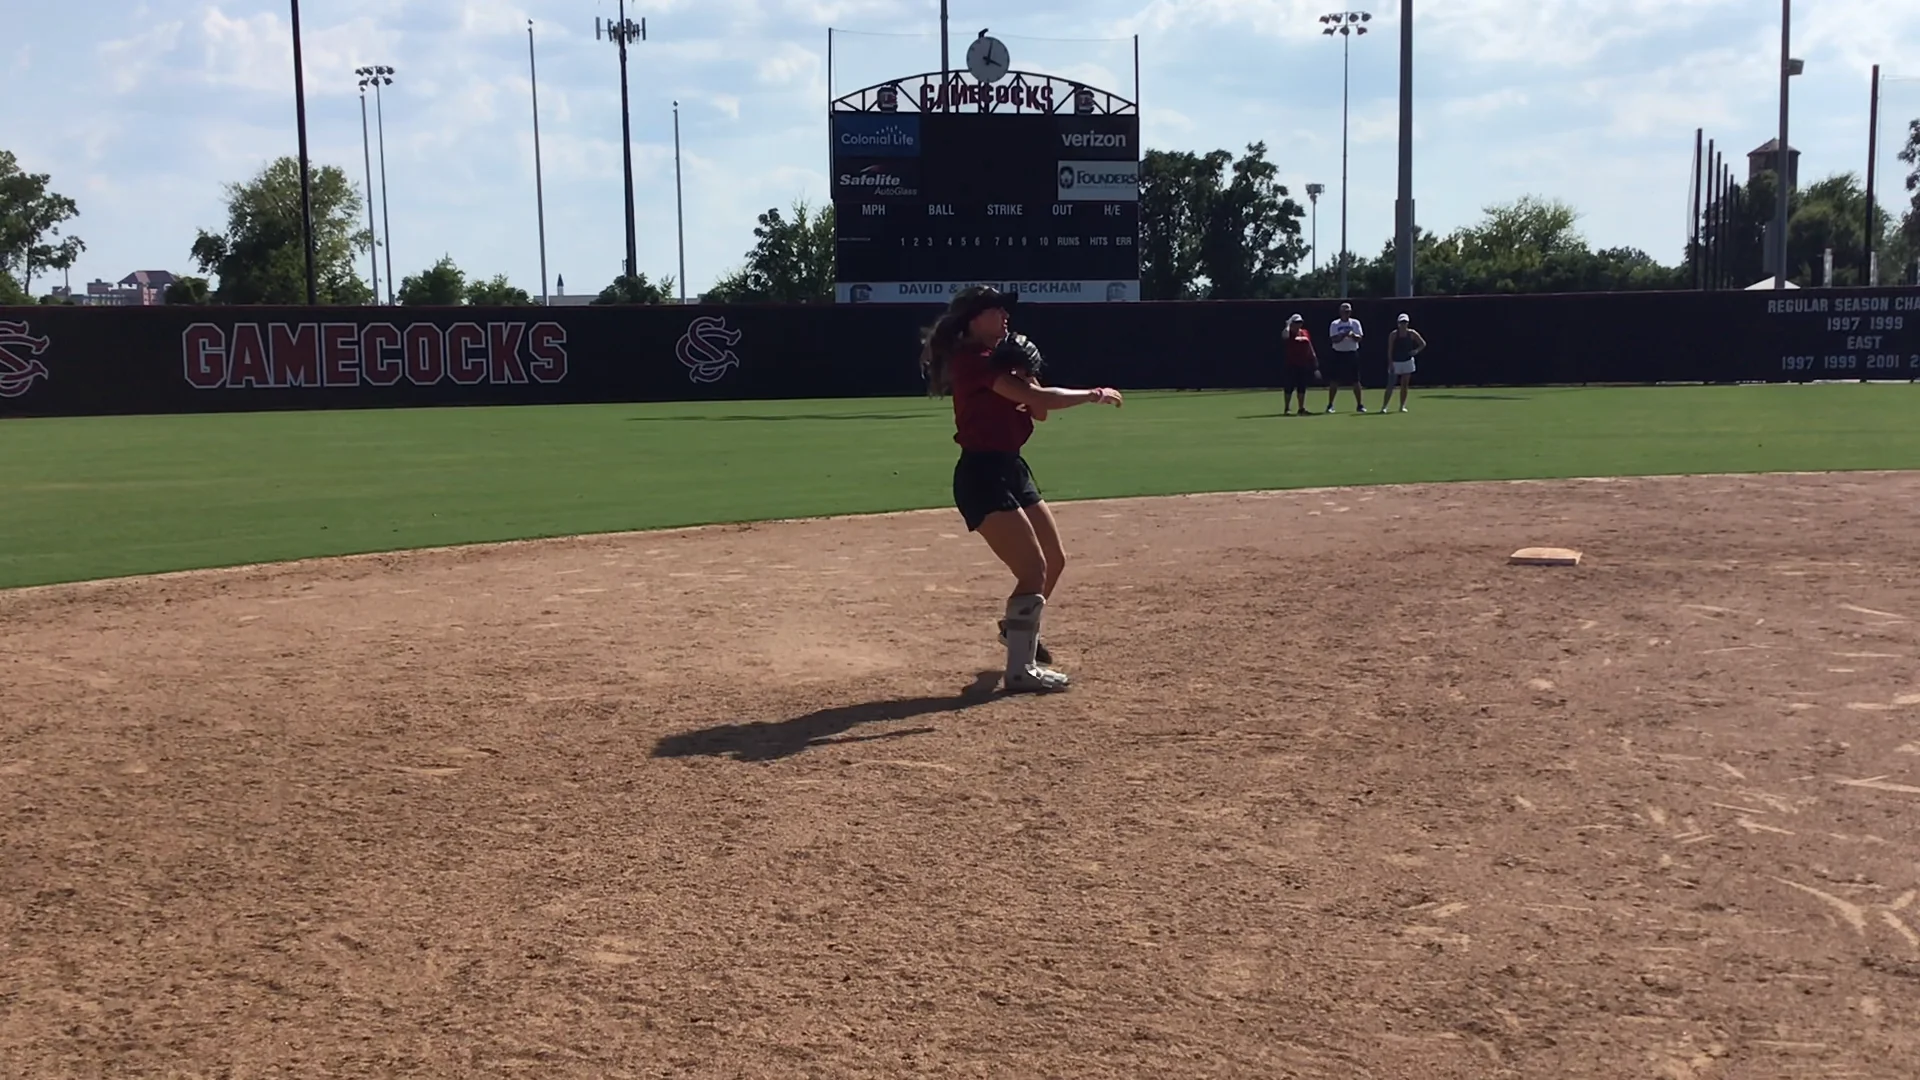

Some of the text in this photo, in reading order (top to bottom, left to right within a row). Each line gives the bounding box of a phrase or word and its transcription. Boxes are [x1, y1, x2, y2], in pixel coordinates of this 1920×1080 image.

[920, 83, 1053, 114] GAMECOCKS
[841, 131, 914, 146] Colonial Life
[1061, 130, 1127, 147] verizon
[839, 173, 901, 186] Safelite
[874, 186, 918, 196] AutoGlass
[862, 204, 1122, 217] MPH BALL STRIKE OUT H/E
[901, 236, 1132, 246] 1 2 3 4 5 6 7 8 9 10 RUNS HITS ERR
[898, 283, 943, 295] DAVID
[948, 284, 958, 294] &
[1009, 282, 1082, 294] BECKHAM
[1767, 298, 1829, 313] REGULAR
[1834, 297, 1889, 312] SEASON
[1827, 316, 1904, 331] 1997 1999
[1846, 336, 1882, 350] EAST
[182, 321, 569, 389] GAMECOCKS
[1782, 356, 1815, 370] 1997
[1824, 356, 1857, 369] 1999
[1866, 355, 1900, 368] 2001
